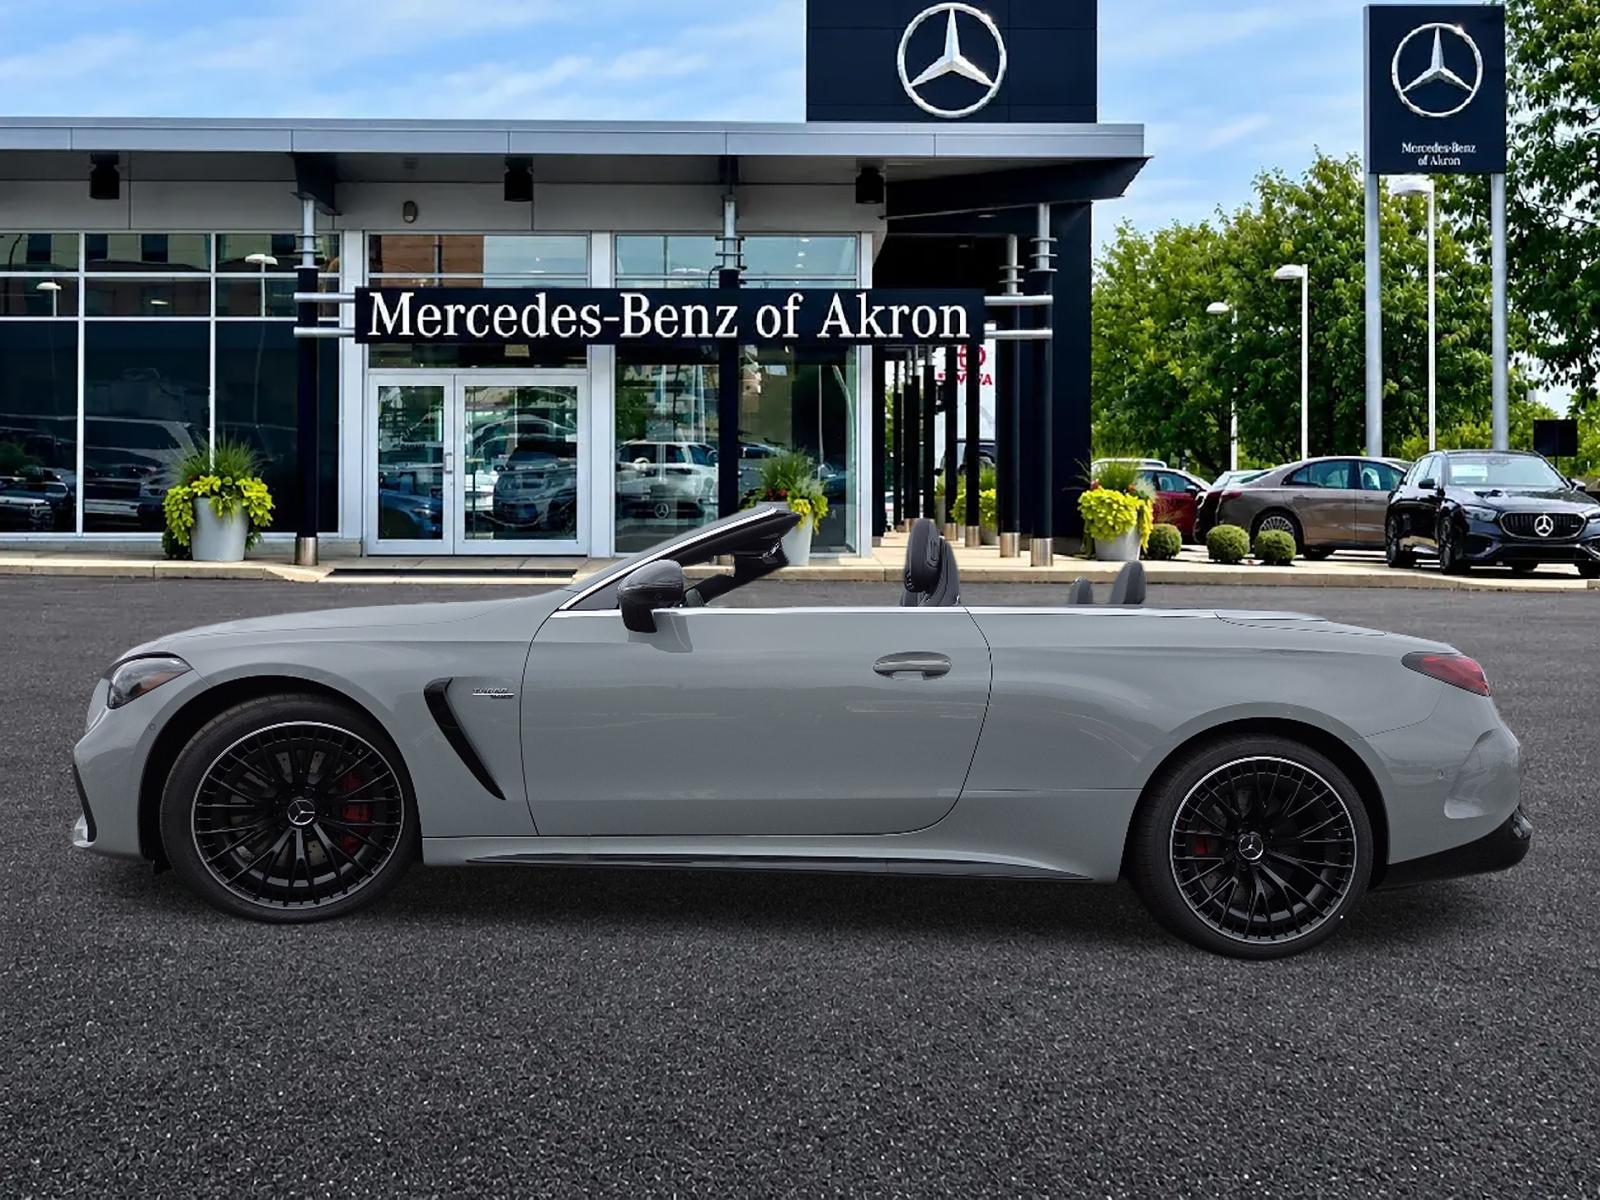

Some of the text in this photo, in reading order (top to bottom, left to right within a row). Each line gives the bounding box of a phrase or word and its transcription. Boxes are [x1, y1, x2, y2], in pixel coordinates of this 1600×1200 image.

[1401, 141, 1477, 153] Mercedes-Benz
[1417, 154, 1461, 166] of Akron
[367, 292, 970, 338] Mercedes-Benz of Akron
